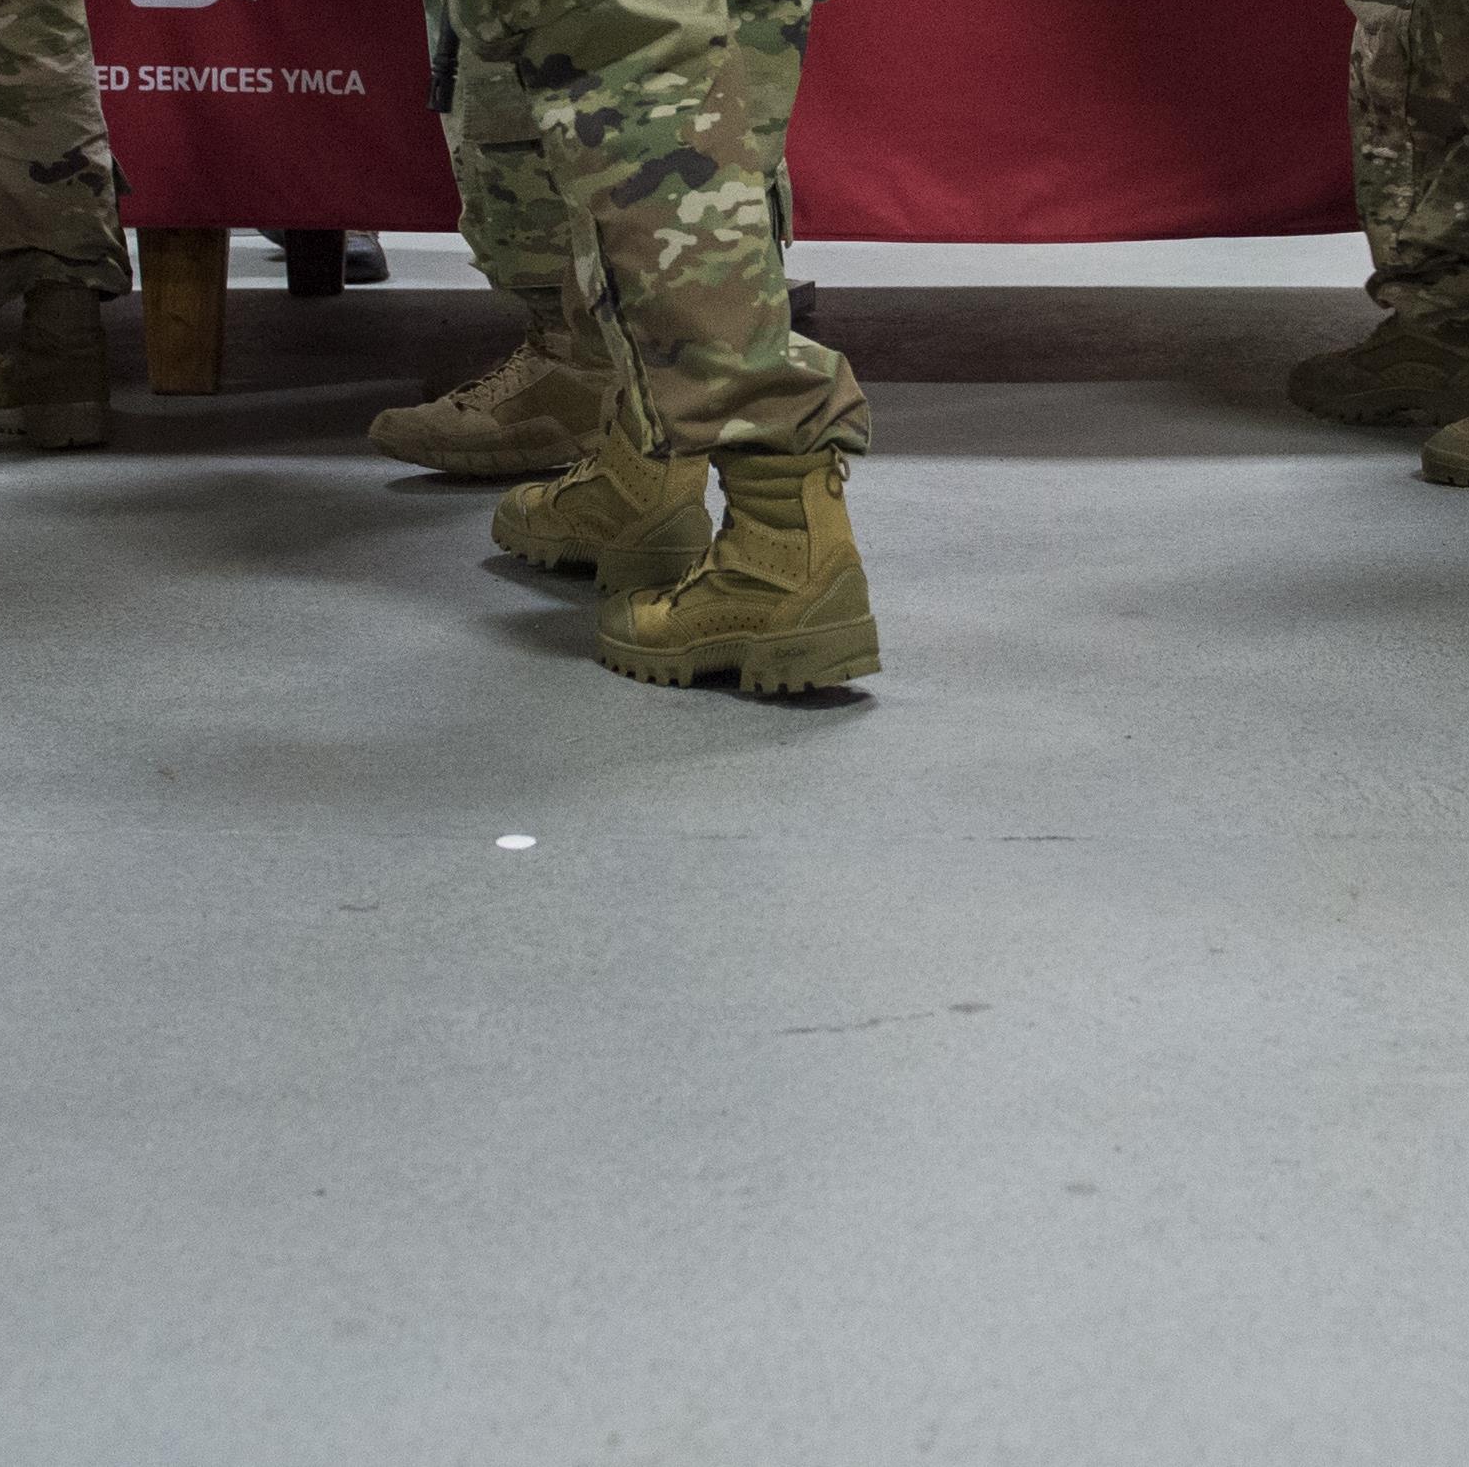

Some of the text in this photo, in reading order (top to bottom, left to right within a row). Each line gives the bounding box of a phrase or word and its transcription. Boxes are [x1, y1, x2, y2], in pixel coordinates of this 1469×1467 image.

[96, 65, 366, 95] ED SERVICES YMCA
